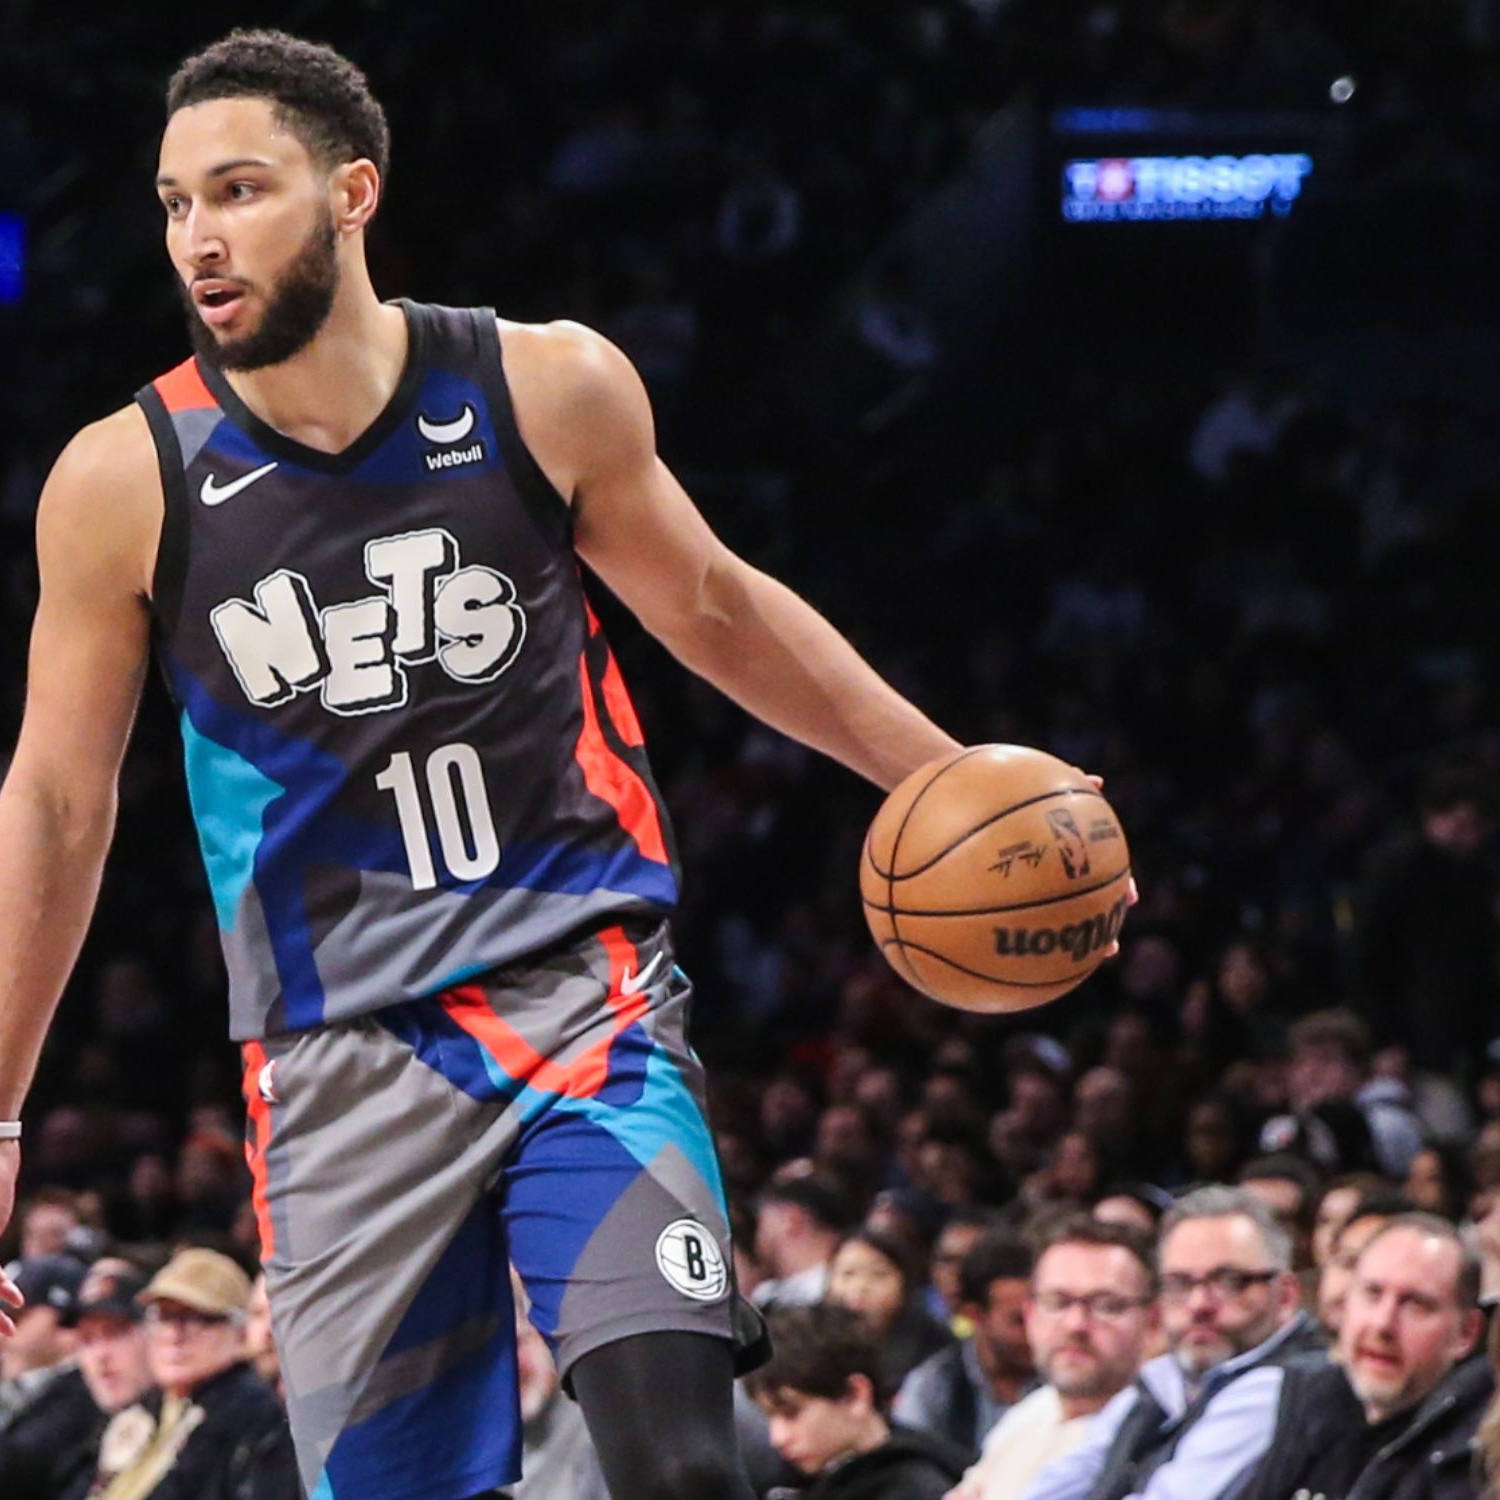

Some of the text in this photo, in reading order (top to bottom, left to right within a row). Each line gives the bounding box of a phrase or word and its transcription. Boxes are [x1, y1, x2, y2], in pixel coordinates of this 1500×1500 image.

[425, 444, 483, 471] Webull
[209, 527, 526, 717] NETS
[375, 742, 501, 891] 10
[683, 1234, 706, 1281] B
